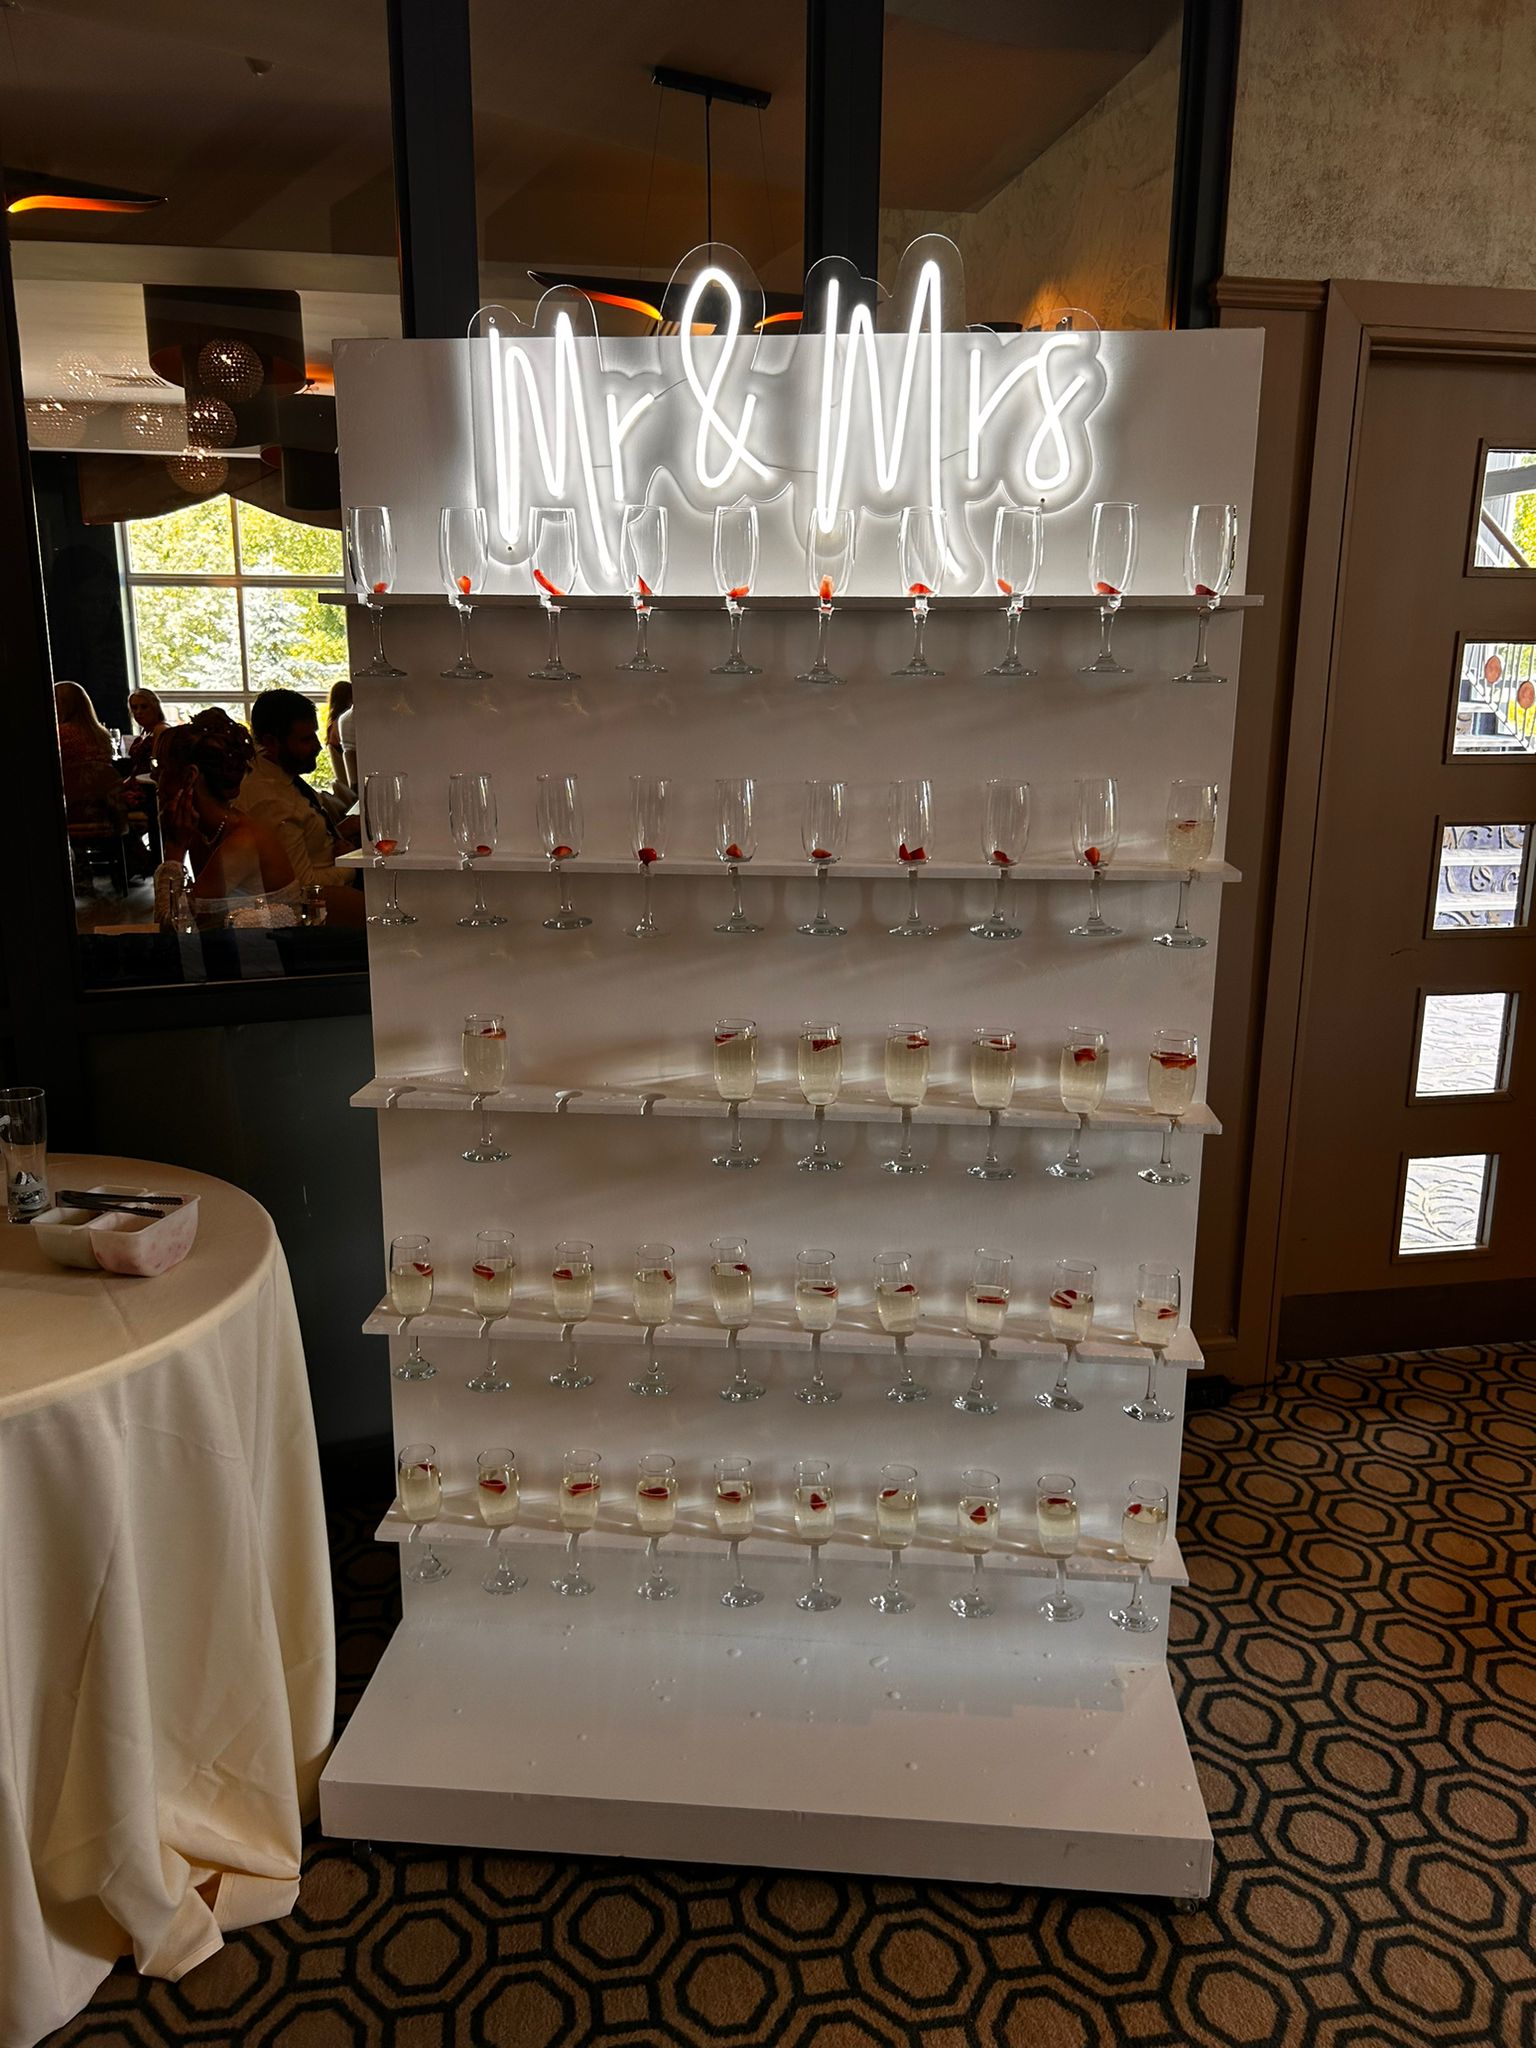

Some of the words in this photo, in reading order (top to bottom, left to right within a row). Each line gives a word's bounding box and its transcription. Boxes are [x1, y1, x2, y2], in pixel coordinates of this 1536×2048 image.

[487, 310, 655, 577] Mr
[680, 267, 771, 489] &
[816, 259, 1088, 580] Mrs
